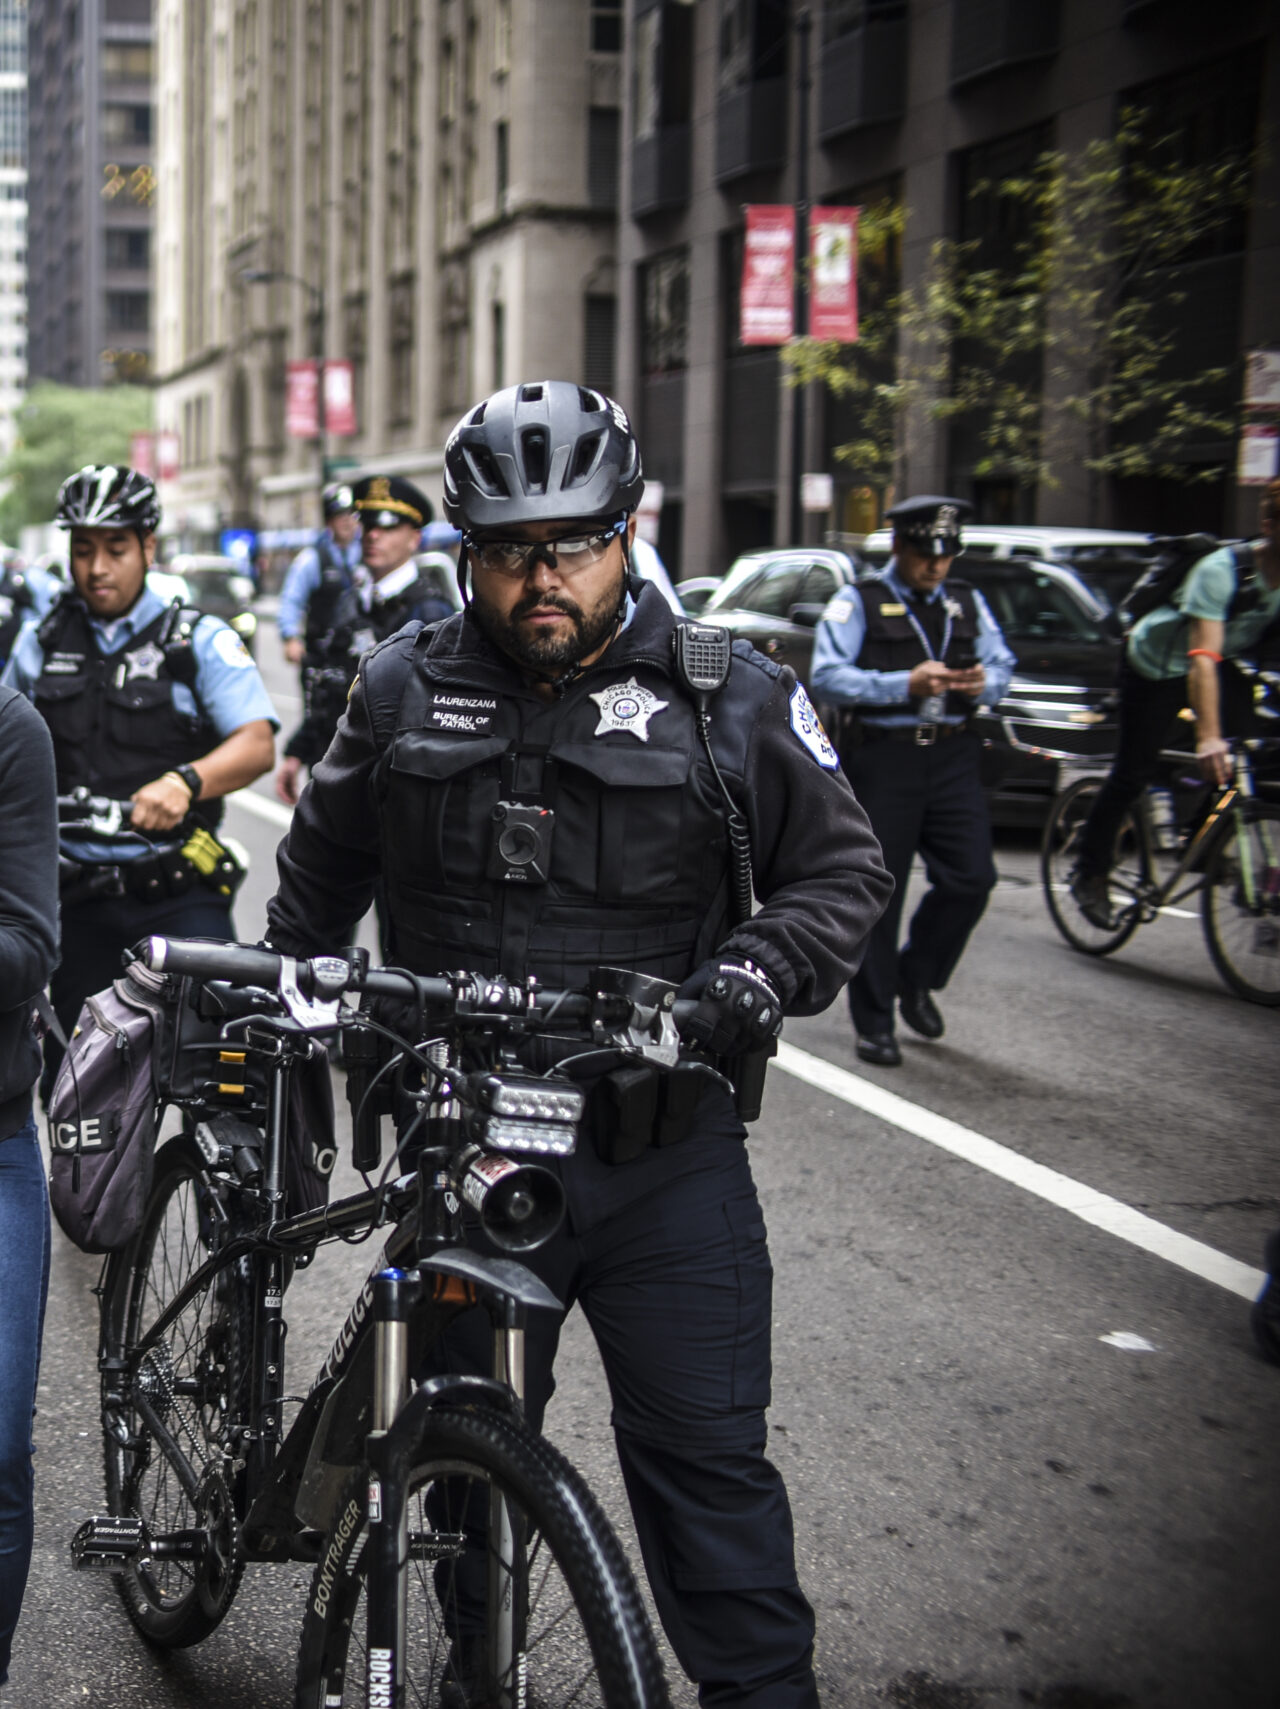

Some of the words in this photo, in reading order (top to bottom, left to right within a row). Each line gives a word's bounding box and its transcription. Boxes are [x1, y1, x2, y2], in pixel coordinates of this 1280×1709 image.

[433, 695, 497, 709] LAURENZANA
[602, 690, 632, 711] CHICAGO
[432, 711, 473, 723] BUREAU
[475, 717, 490, 725] OF
[440, 719, 477, 731] PATROL
[94, 1527, 140, 1535] BONTRAGER
[314, 1499, 362, 1620] BONTRAGER
[369, 1648, 392, 1709] ROCKS
